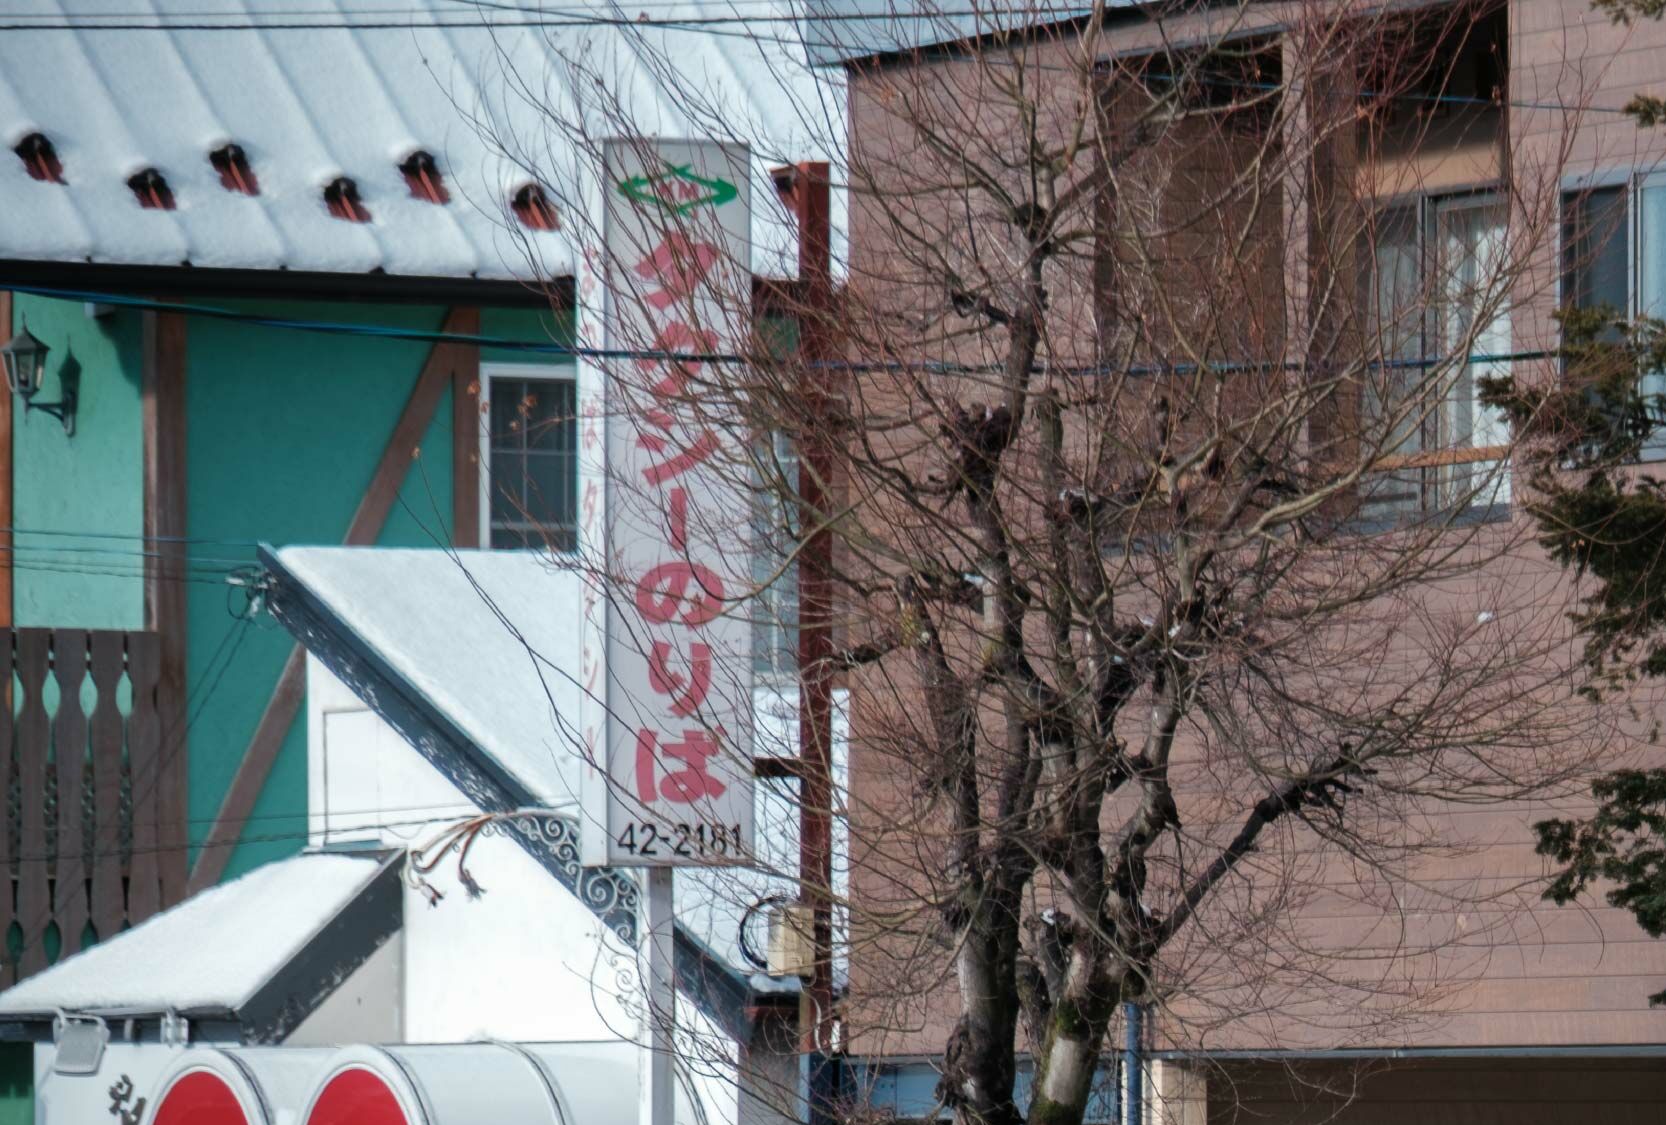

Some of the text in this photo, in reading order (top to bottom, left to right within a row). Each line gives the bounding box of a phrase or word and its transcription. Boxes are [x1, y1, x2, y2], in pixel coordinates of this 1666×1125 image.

[633, 230, 727, 803] タクシーのりば
[617, 812, 742, 856] 42-2181
